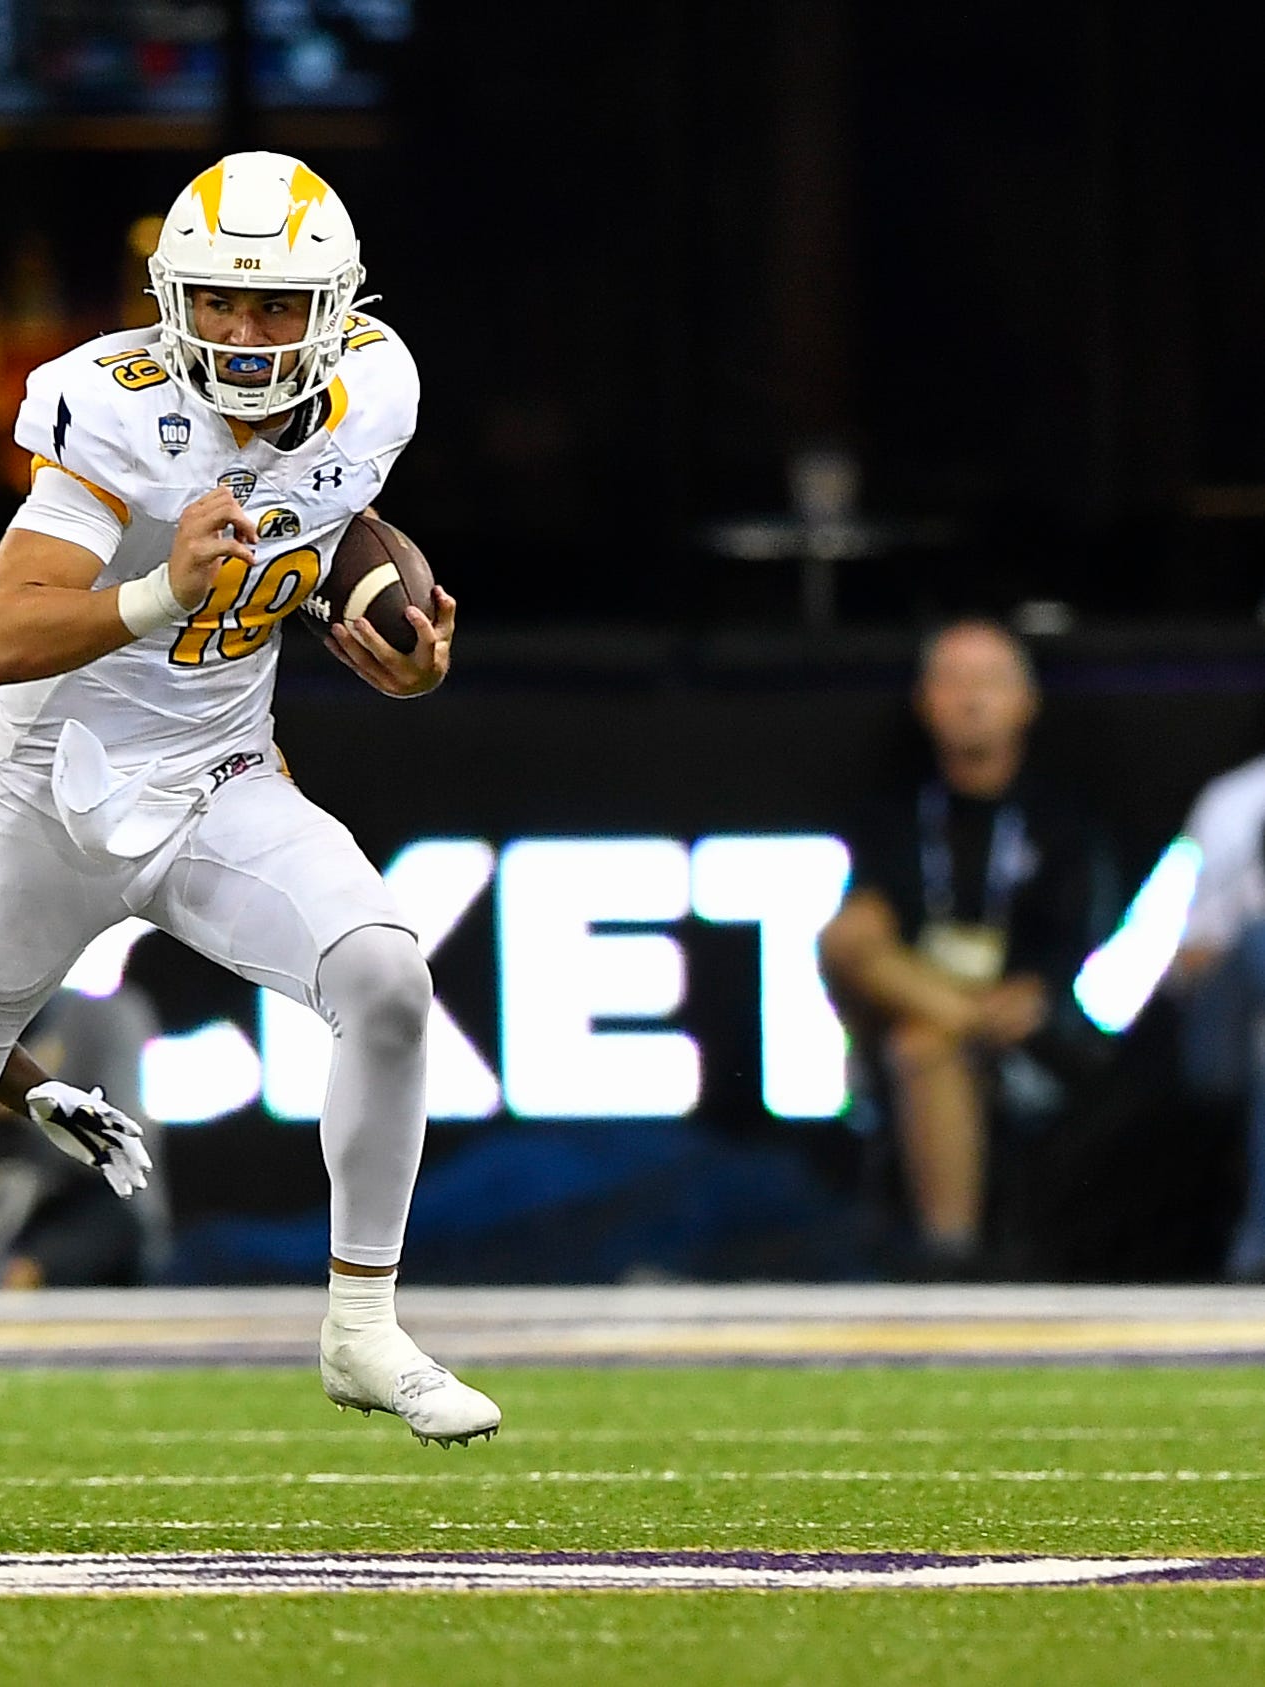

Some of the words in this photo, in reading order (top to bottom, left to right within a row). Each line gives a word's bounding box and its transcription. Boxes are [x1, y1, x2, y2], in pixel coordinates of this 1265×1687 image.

[233, 258, 261, 269] 301
[93, 347, 170, 391] 19
[161, 424, 188, 442] 100
